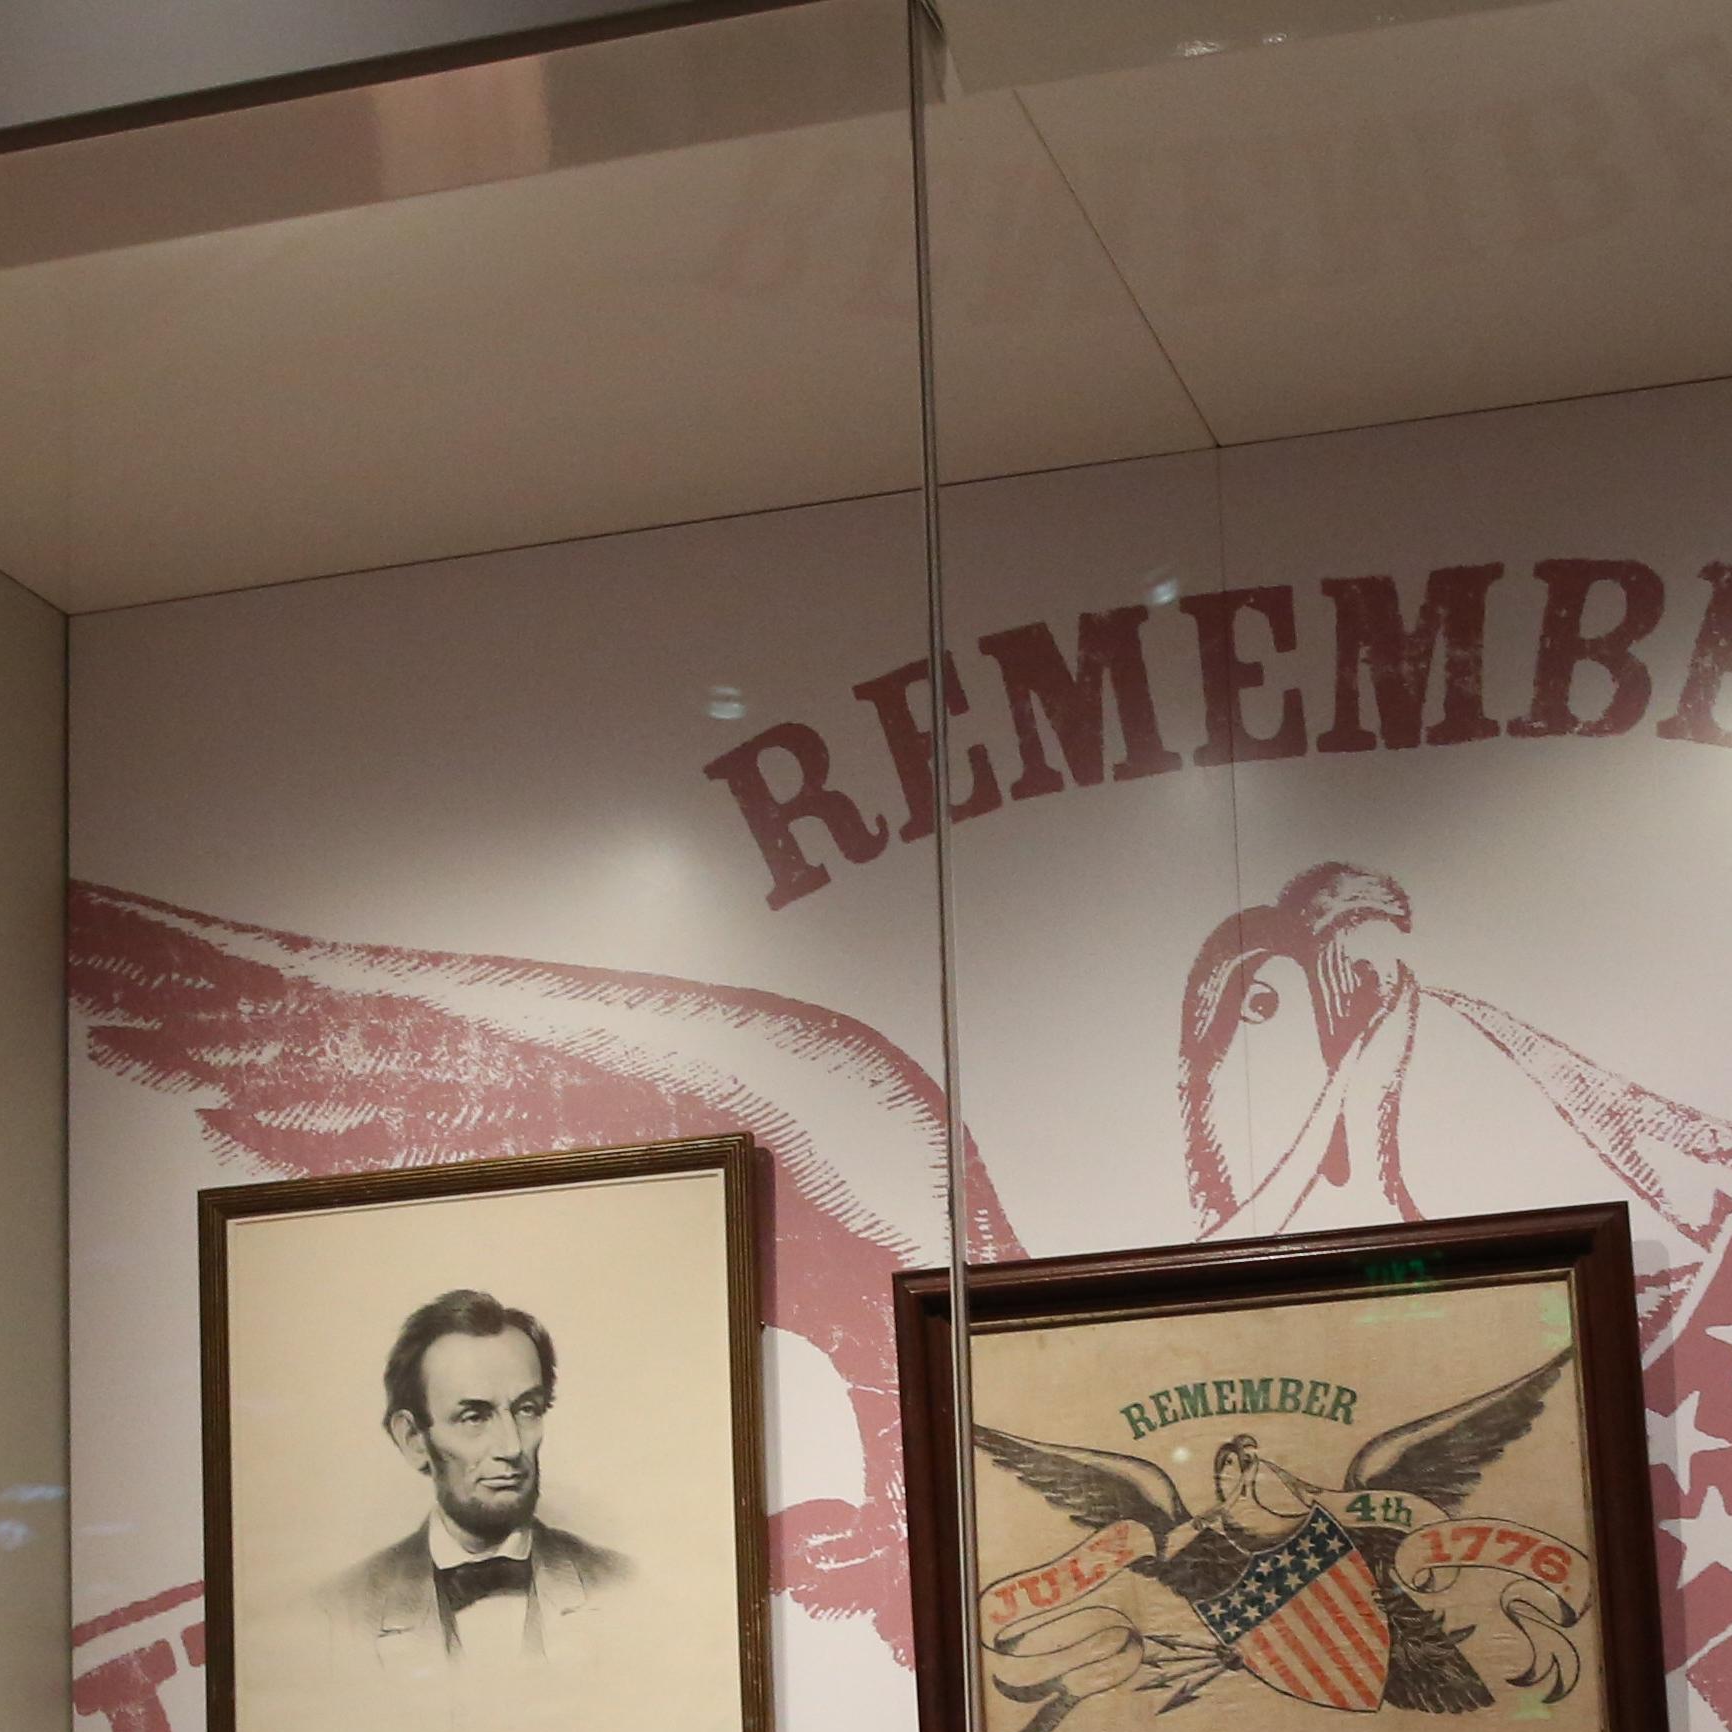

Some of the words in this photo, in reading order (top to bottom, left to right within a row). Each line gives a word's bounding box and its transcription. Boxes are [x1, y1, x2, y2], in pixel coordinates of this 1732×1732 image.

[1119, 1376, 1360, 1440] REMEMBER
[1344, 1492, 1416, 1528] 4th
[988, 1522, 1131, 1626] JULY
